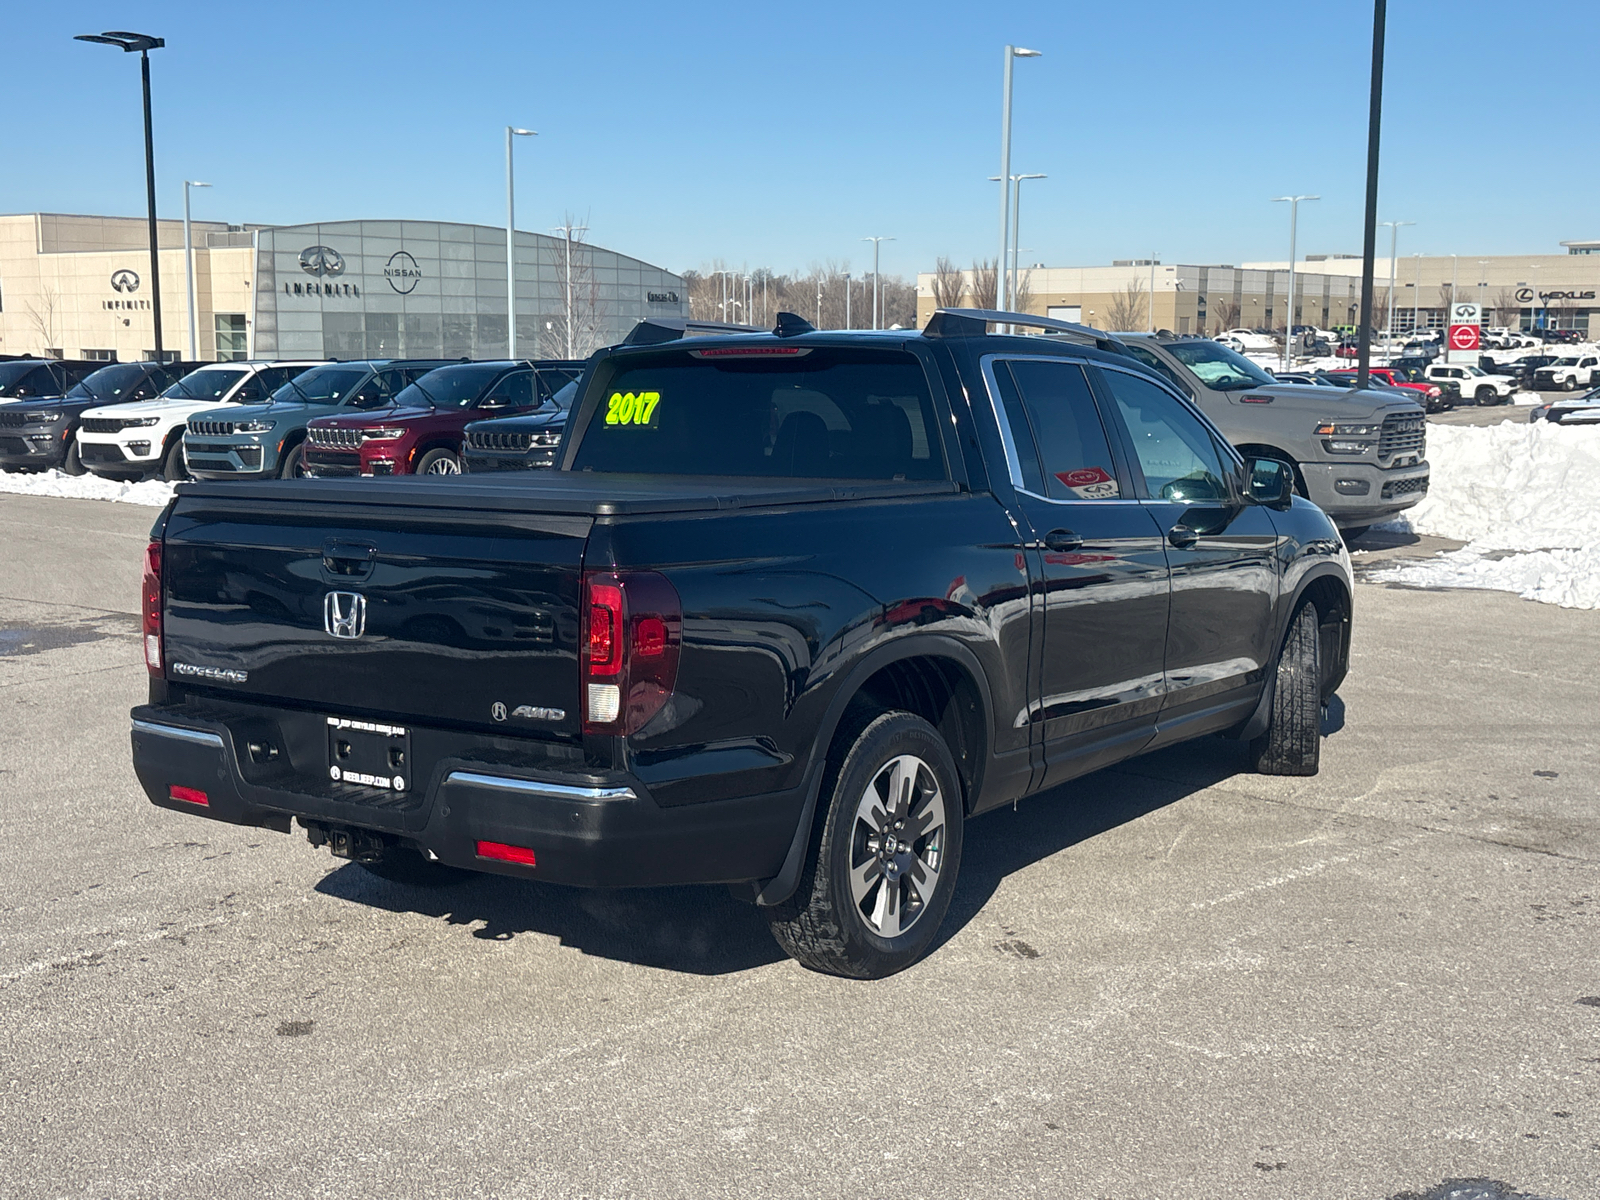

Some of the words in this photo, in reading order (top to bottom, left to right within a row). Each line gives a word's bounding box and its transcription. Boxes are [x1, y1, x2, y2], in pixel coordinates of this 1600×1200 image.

[384, 268, 422, 277] NISSAN
[285, 282, 358, 296] INFINITI
[102, 300, 151, 310] INFINITI
[605, 392, 660, 425] 2017
[173, 662, 249, 683] RIDGELINE
[511, 704, 566, 720] AWD
